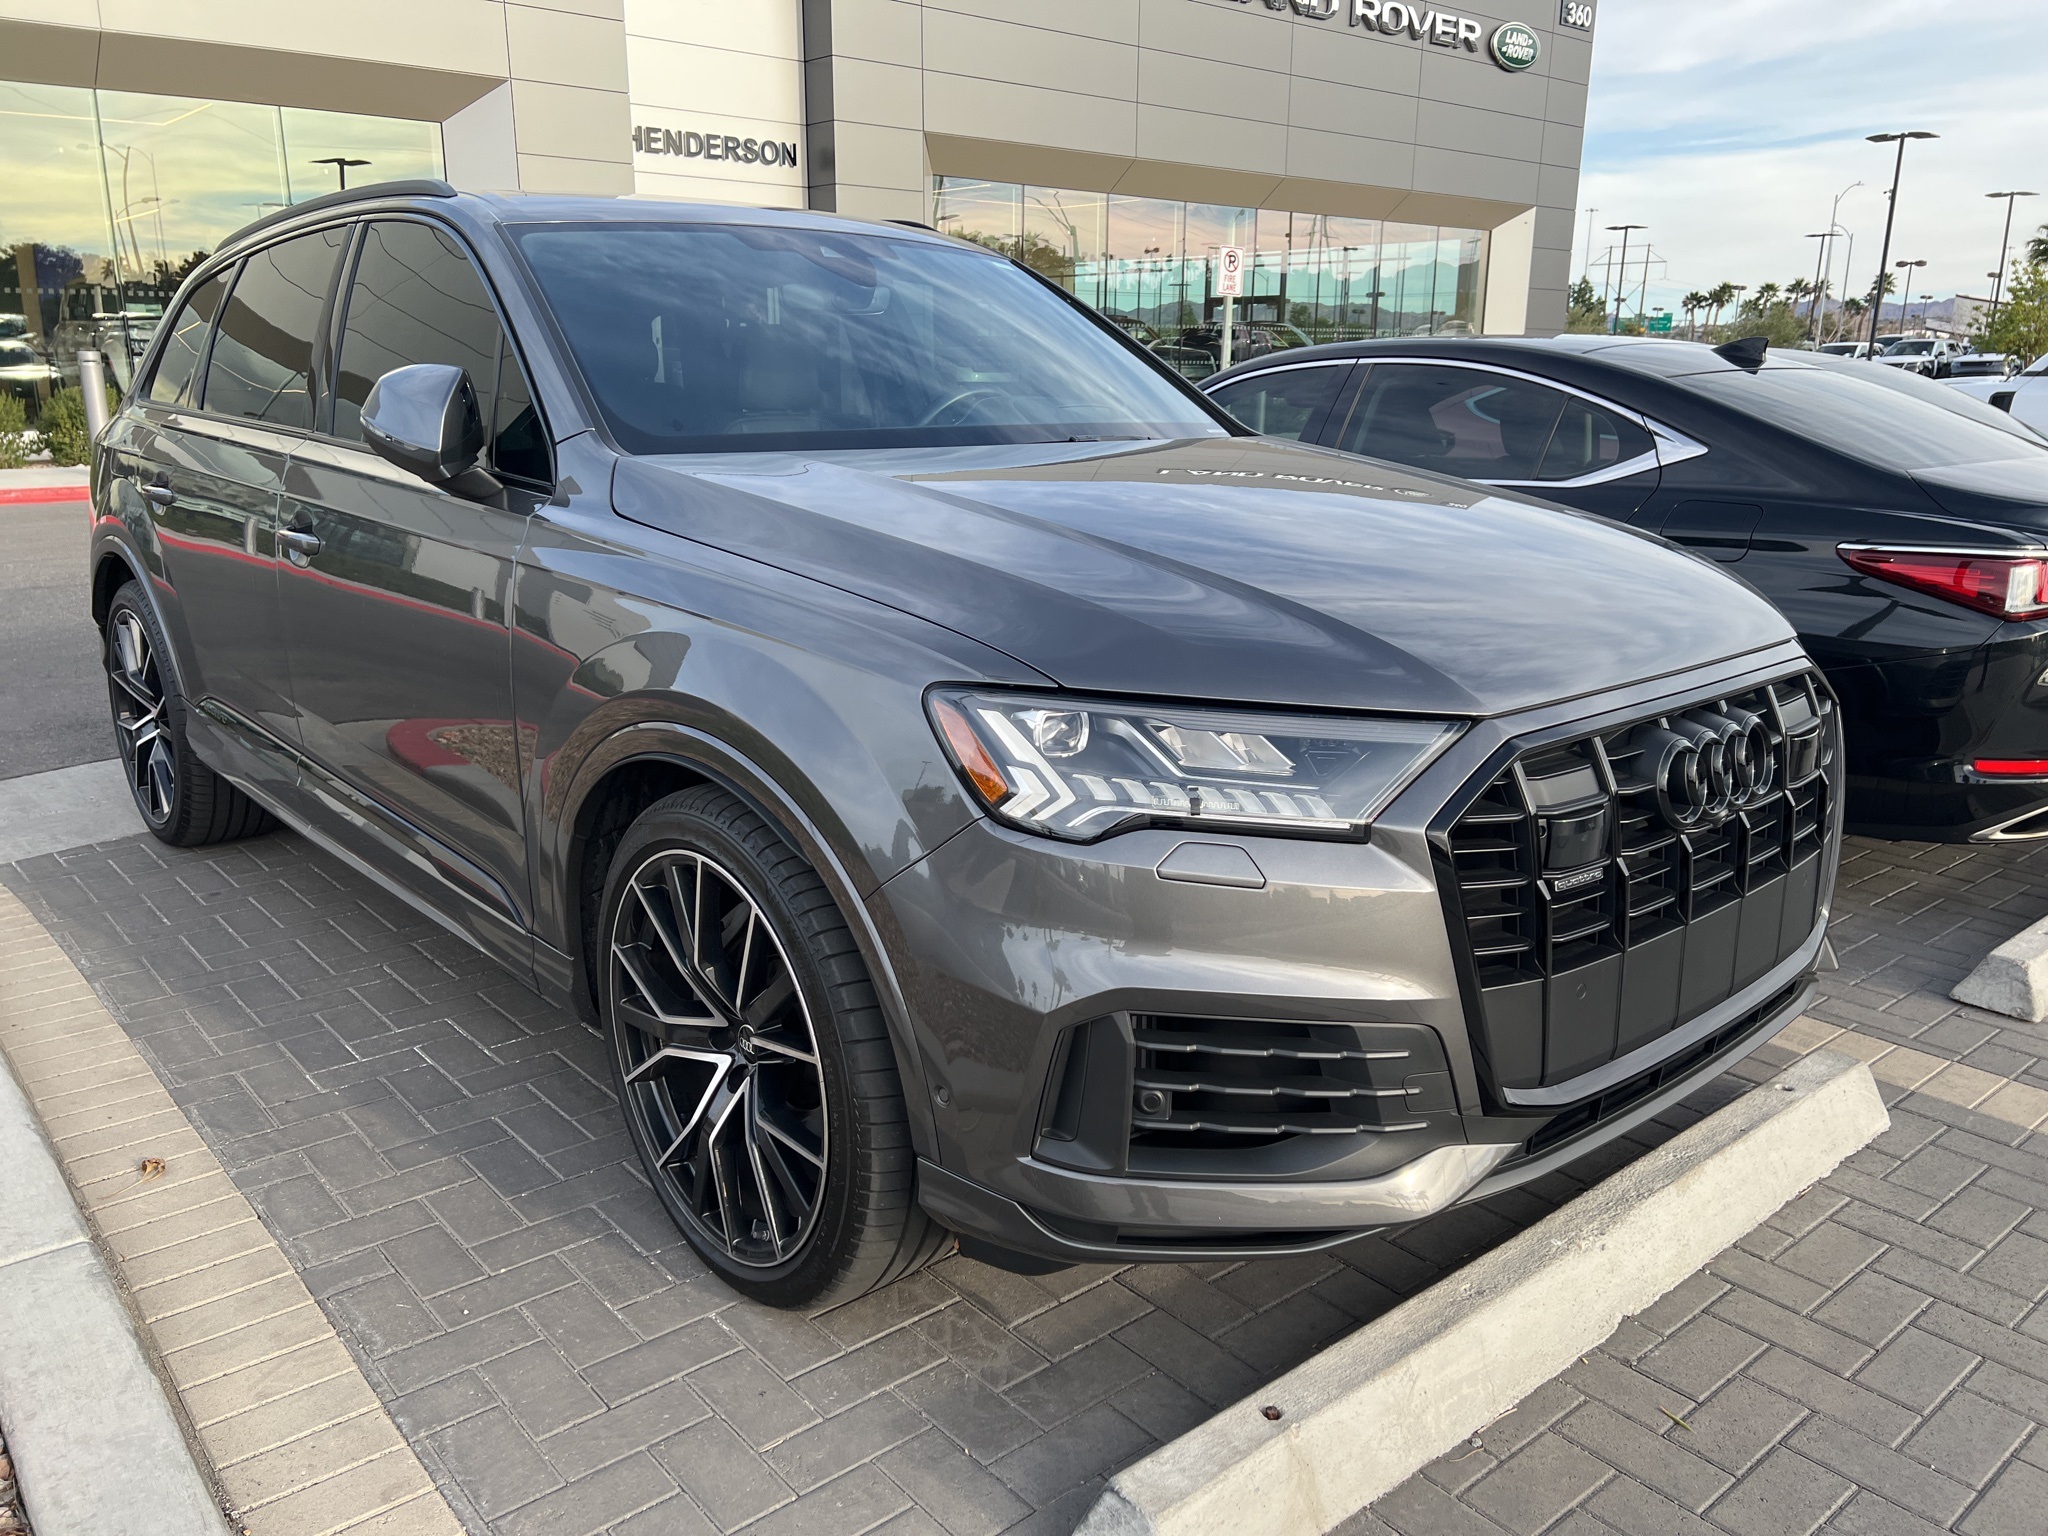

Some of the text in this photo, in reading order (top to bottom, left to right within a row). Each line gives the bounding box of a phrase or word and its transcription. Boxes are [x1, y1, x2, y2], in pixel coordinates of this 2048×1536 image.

[1566, 2, 1592, 27] 360
[1349, 0, 1482, 53] ROVER
[1505, 30, 1529, 47] LAND
[1504, 44, 1534, 61] ROVER
[632, 125, 798, 168] HENDERSON
[1557, 869, 1602, 889] quattro
